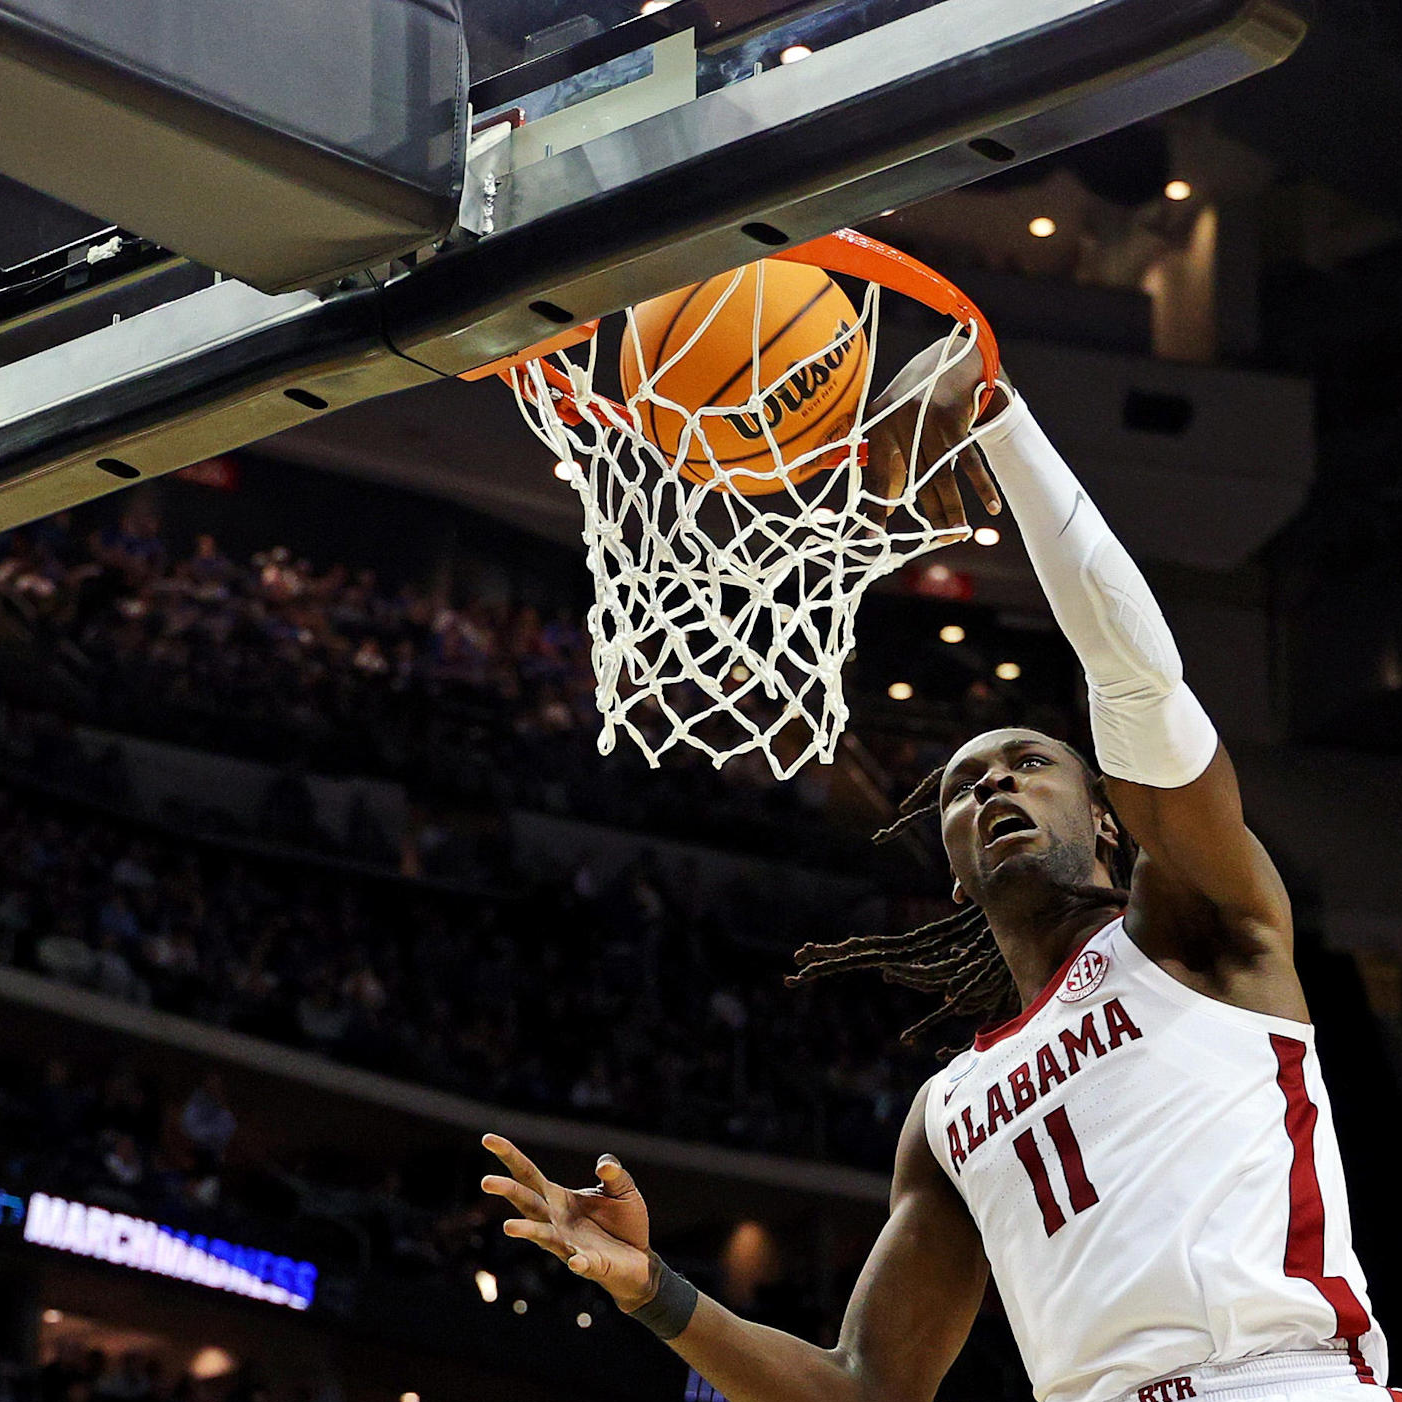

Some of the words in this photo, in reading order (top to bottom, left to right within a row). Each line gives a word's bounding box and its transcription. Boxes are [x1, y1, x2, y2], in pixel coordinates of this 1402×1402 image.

[1067, 952, 1102, 991] SEC
[946, 997, 1144, 1178] ALABAMA
[1012, 1103, 1100, 1239] 11
[23, 1191, 318, 1311] MARCHMADNESS
